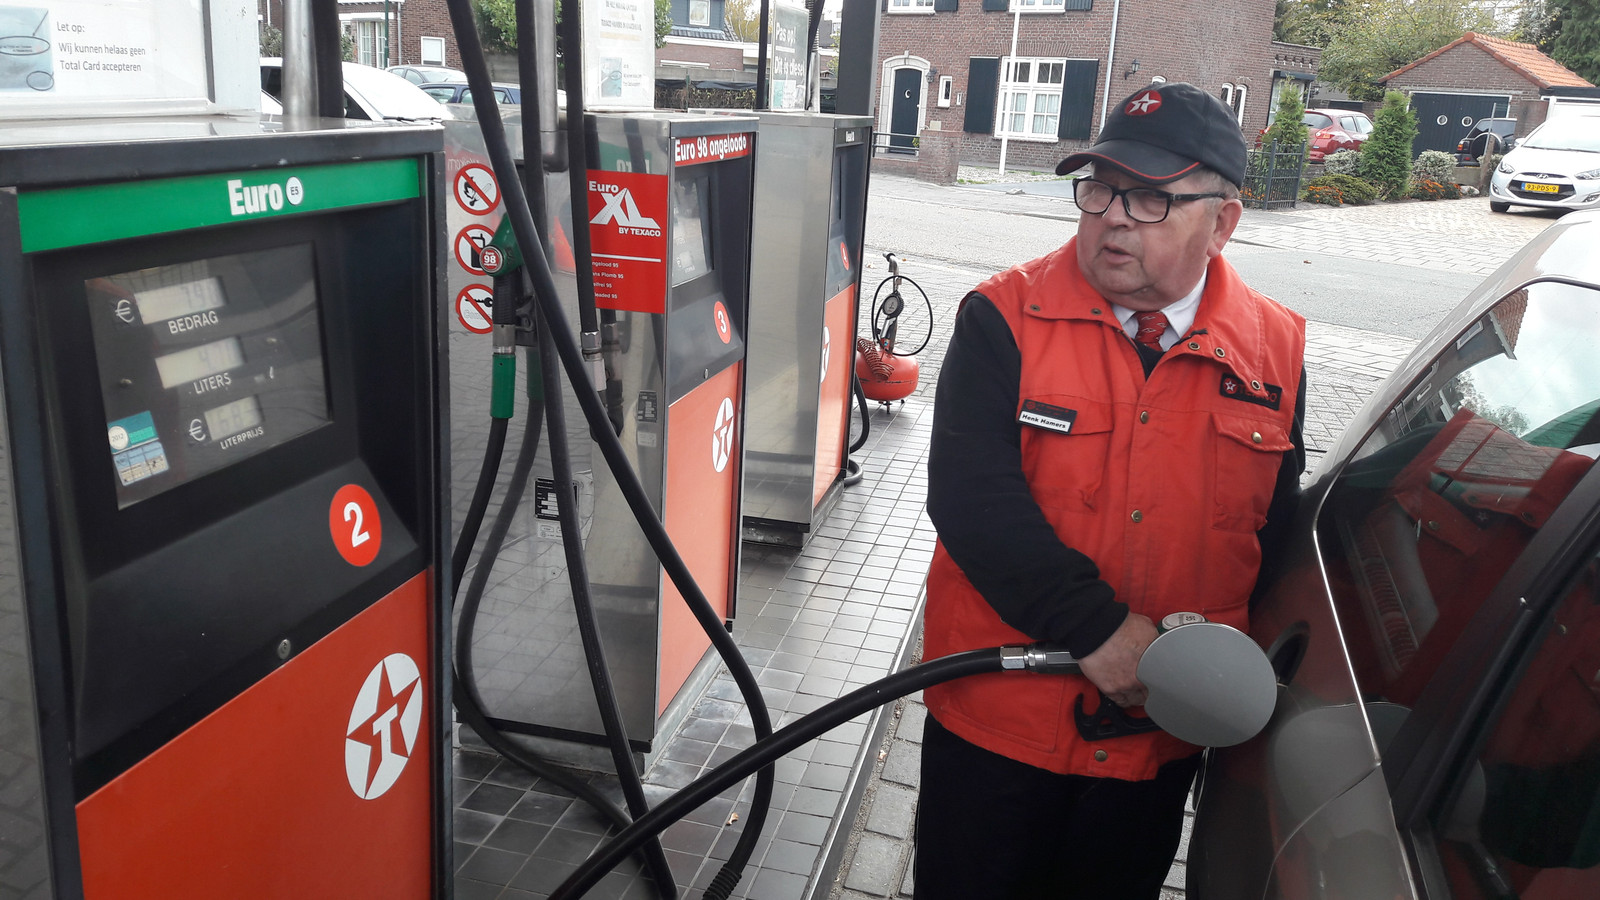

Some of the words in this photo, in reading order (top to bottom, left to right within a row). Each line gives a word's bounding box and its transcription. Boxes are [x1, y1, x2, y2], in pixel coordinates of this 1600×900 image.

[57, 21, 70, 32] Let
[71, 24, 85, 34] op:
[776, 22, 787, 42] Pas
[788, 26, 796, 46] op!
[58, 42, 73, 55] Wij
[74, 43, 103, 54] kunnen
[104, 44, 128, 55] helaas
[129, 47, 146, 57] geen
[60, 60, 80, 71] Total
[82, 61, 100, 71] Card
[102, 62, 142, 73] accepteren
[774, 55, 783, 75] Dit
[675, 139, 696, 162] Euro
[697, 136, 708, 159] 98
[227, 179, 284, 216] Euro
[290, 186, 299, 196] E5
[588, 180, 620, 194] Euro
[589, 187, 661, 230] XL
[618, 226, 629, 235] BY
[630, 228, 661, 237] TEXACO
[484, 256, 497, 264] 98
[168, 310, 219, 334] BEDRAG
[717, 309, 727, 333] 3
[193, 372, 232, 395] LITERS
[1022, 413, 1039, 422] Henk
[1041, 418, 1066, 429] Hamers
[111, 432, 124, 442] 2012
[219, 425, 264, 450] LITERPRIJS
[343, 501, 370, 548] 2
